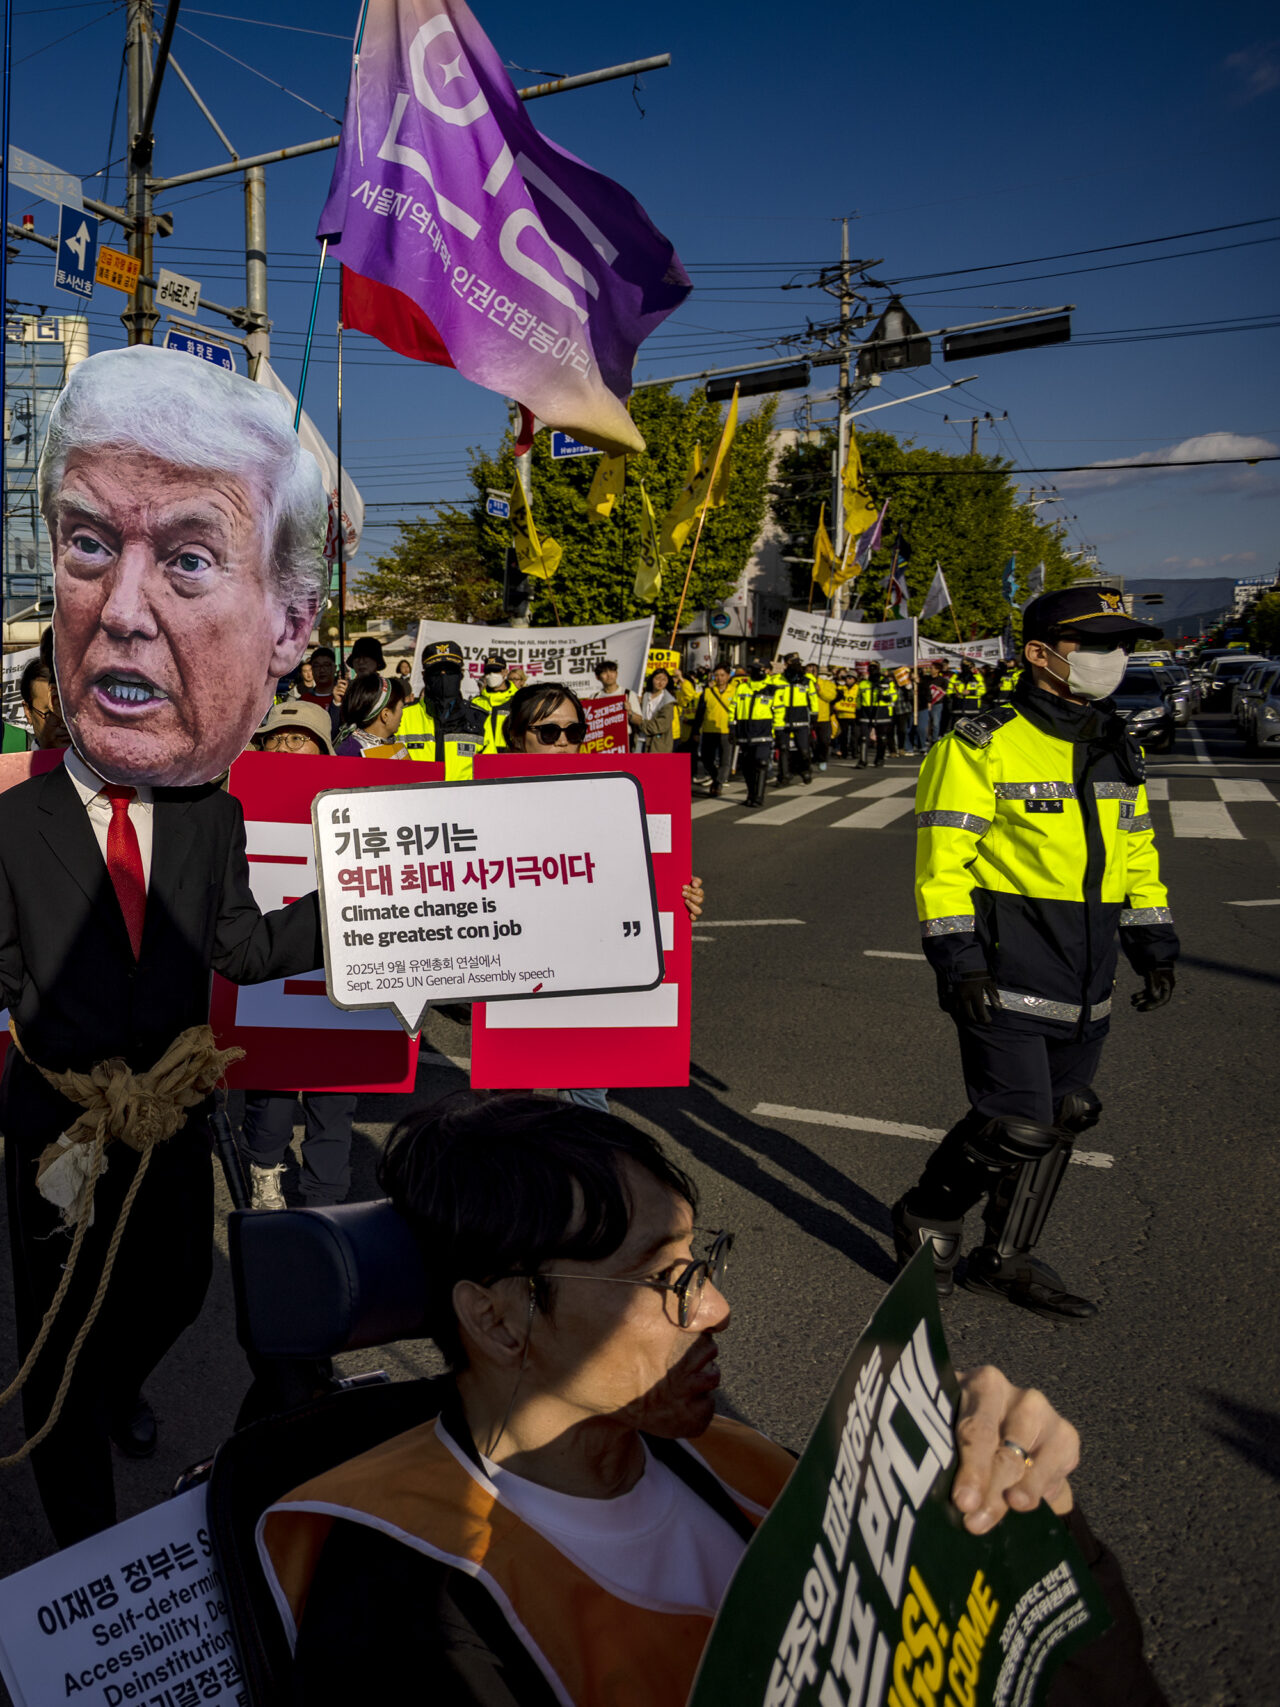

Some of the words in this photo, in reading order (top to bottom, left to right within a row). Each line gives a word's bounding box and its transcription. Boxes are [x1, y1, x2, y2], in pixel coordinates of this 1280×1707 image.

[351, 179, 451, 274] 서울지역대학
[451, 264, 591, 379] 인권연합동아리
[579, 735, 614, 753] APEC
[334, 826, 390, 860] 기후
[396, 822, 478, 856] 위기는
[337, 863, 394, 898] 역대
[400, 860, 456, 894] 최대
[462, 852, 596, 890] 사기극이다
[341, 902, 410, 923] Climate
[414, 899, 479, 921] change
[482, 898, 497, 914] is
[343, 929, 374, 948] the
[378, 924, 453, 949] greatest
[457, 924, 490, 941] con
[492, 920, 523, 942] job
[346, 961, 386, 977] 2025년
[387, 960, 406, 975] 9월
[409, 957, 455, 973] 유엔총회
[456, 954, 502, 970] 연설에서
[347, 978, 373, 993] Sept.
[376, 976, 404, 991] 2025
[406, 975, 424, 989] UN
[426, 973, 466, 988] General
[468, 970, 517, 986] Assembly
[519, 967, 556, 983] speech
[823, 1345, 883, 1572] 파괴하는
[858, 1318, 954, 1610] 반대!
[37, 1574, 119, 1635] 이재명
[120, 1542, 198, 1594] 정부는
[92, 1567, 220, 1647] Self-determin
[64, 1614, 210, 1698] Accessibility,
[103, 1628, 235, 1707] Deinstitution
